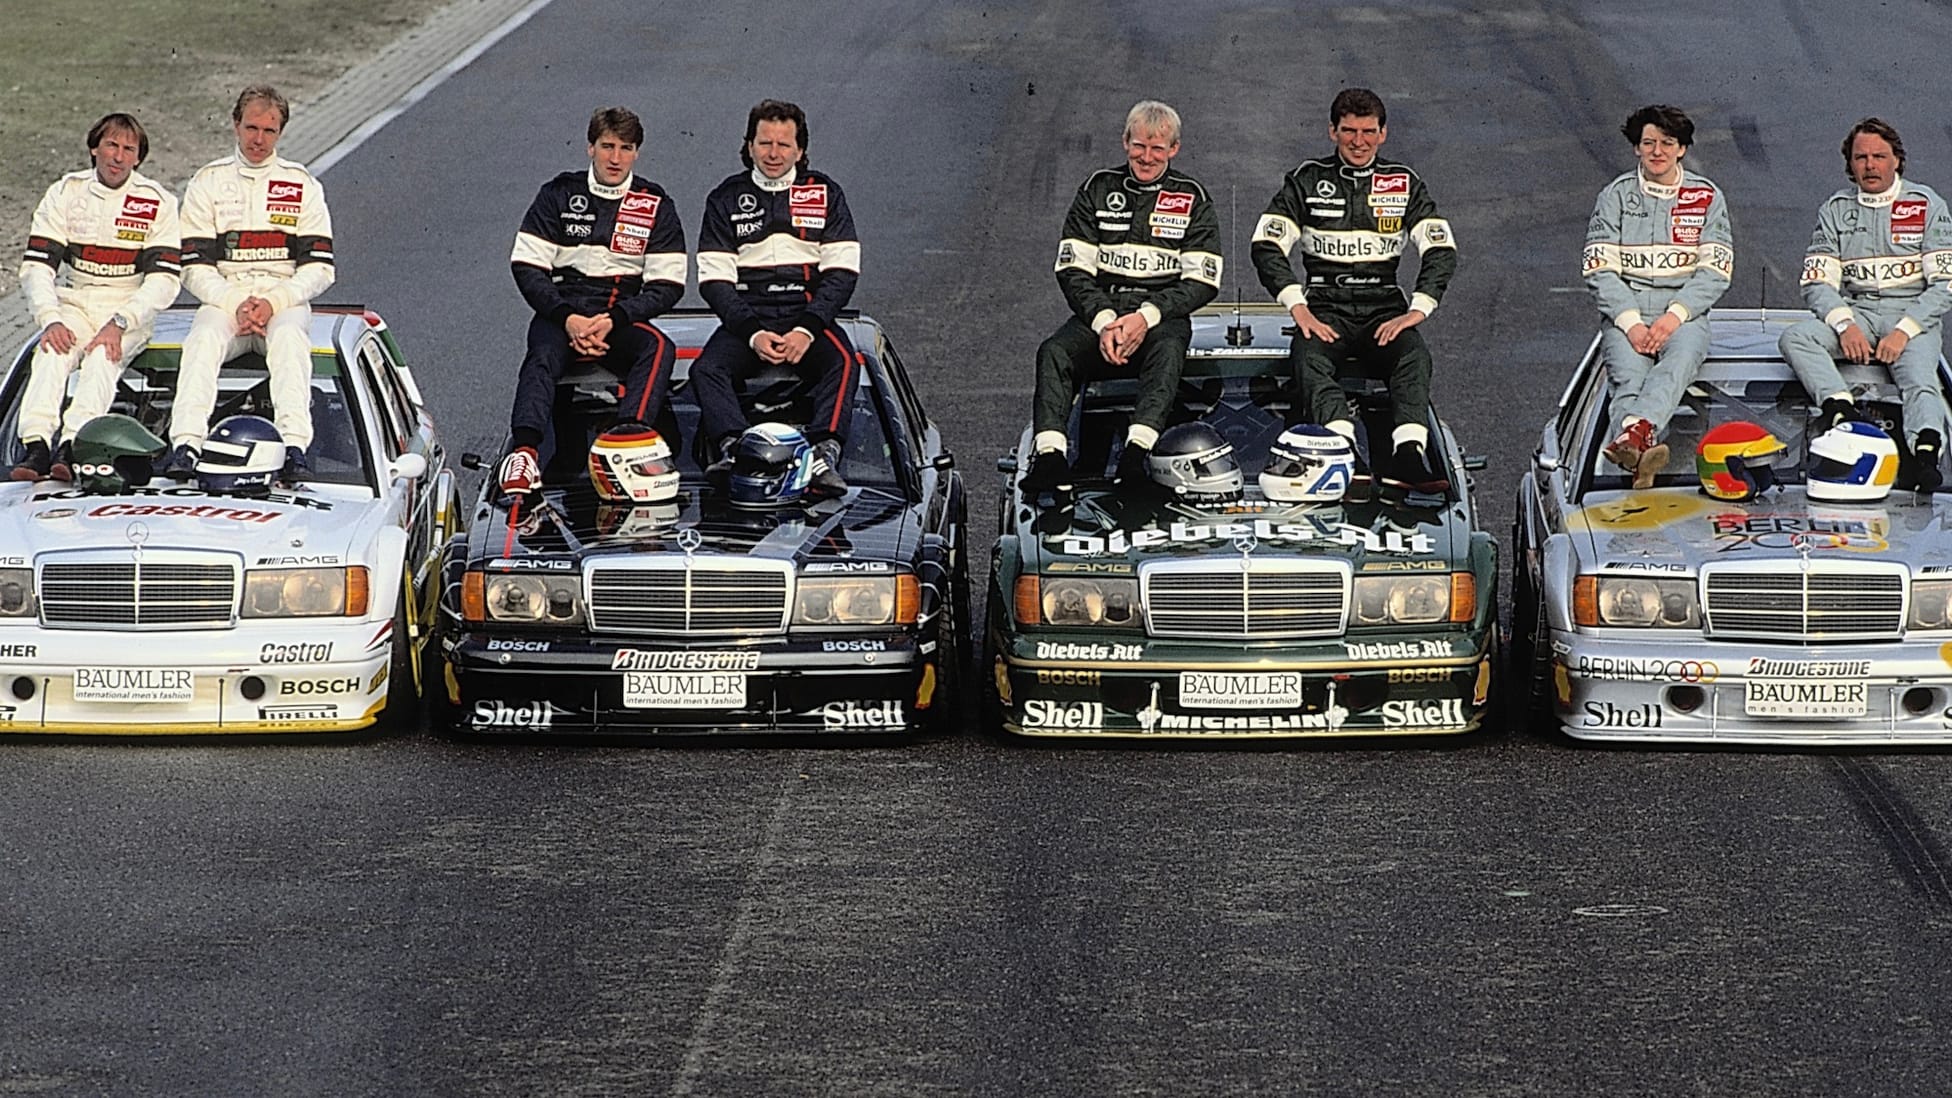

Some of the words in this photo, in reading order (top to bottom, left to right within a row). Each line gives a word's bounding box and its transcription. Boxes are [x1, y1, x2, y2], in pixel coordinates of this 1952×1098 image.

[1152, 216, 1187, 225] MICHELIN
[1313, 236, 1371, 256] Diebels
[87, 503, 283, 523] Castrol
[1064, 520, 1315, 555] Diebels
[1330, 525, 1438, 554] Alt
[259, 642, 335, 664] Castrol
[487, 640, 550, 652] BOSCH
[823, 640, 886, 652] BOSCH
[1037, 642, 1108, 660] Diebels
[1109, 643, 1143, 660] Alt
[1346, 641, 1419, 660] Diebels
[1421, 639, 1454, 658] Alt
[614, 650, 759, 670] BRIDGESTONE
[1580, 656, 1646, 675] BERLIN
[1651, 660, 1719, 682] 2000
[1747, 658, 1870, 676] BRIDGESTONE
[76, 668, 192, 689] BÄUMLER
[627, 674, 743, 696] BÄUMLER
[1038, 670, 1101, 687] BOSCH
[1183, 674, 1299, 696] BÄUMLER
[1388, 667, 1452, 684] BOSCH
[76, 691, 129, 700] international
[131, 691, 159, 700] men's
[161, 691, 191, 700] fashion
[280, 677, 360, 695] BOSCH
[1749, 681, 1864, 703] BÄUMLER
[626, 696, 680, 706] international
[683, 696, 708, 706] men's
[711, 696, 743, 706] fashion
[1182, 696, 1236, 706] international
[1238, 696, 1264, 706] men's
[1266, 696, 1299, 706] fashion
[258, 704, 338, 721] PIRELLI
[472, 700, 553, 727] Shell
[823, 700, 906, 727] Shell
[1022, 700, 1104, 728] Shell
[1160, 713, 1326, 729] MICHELIN
[1382, 699, 1467, 728] Shell
[1583, 701, 1663, 729] Shell
